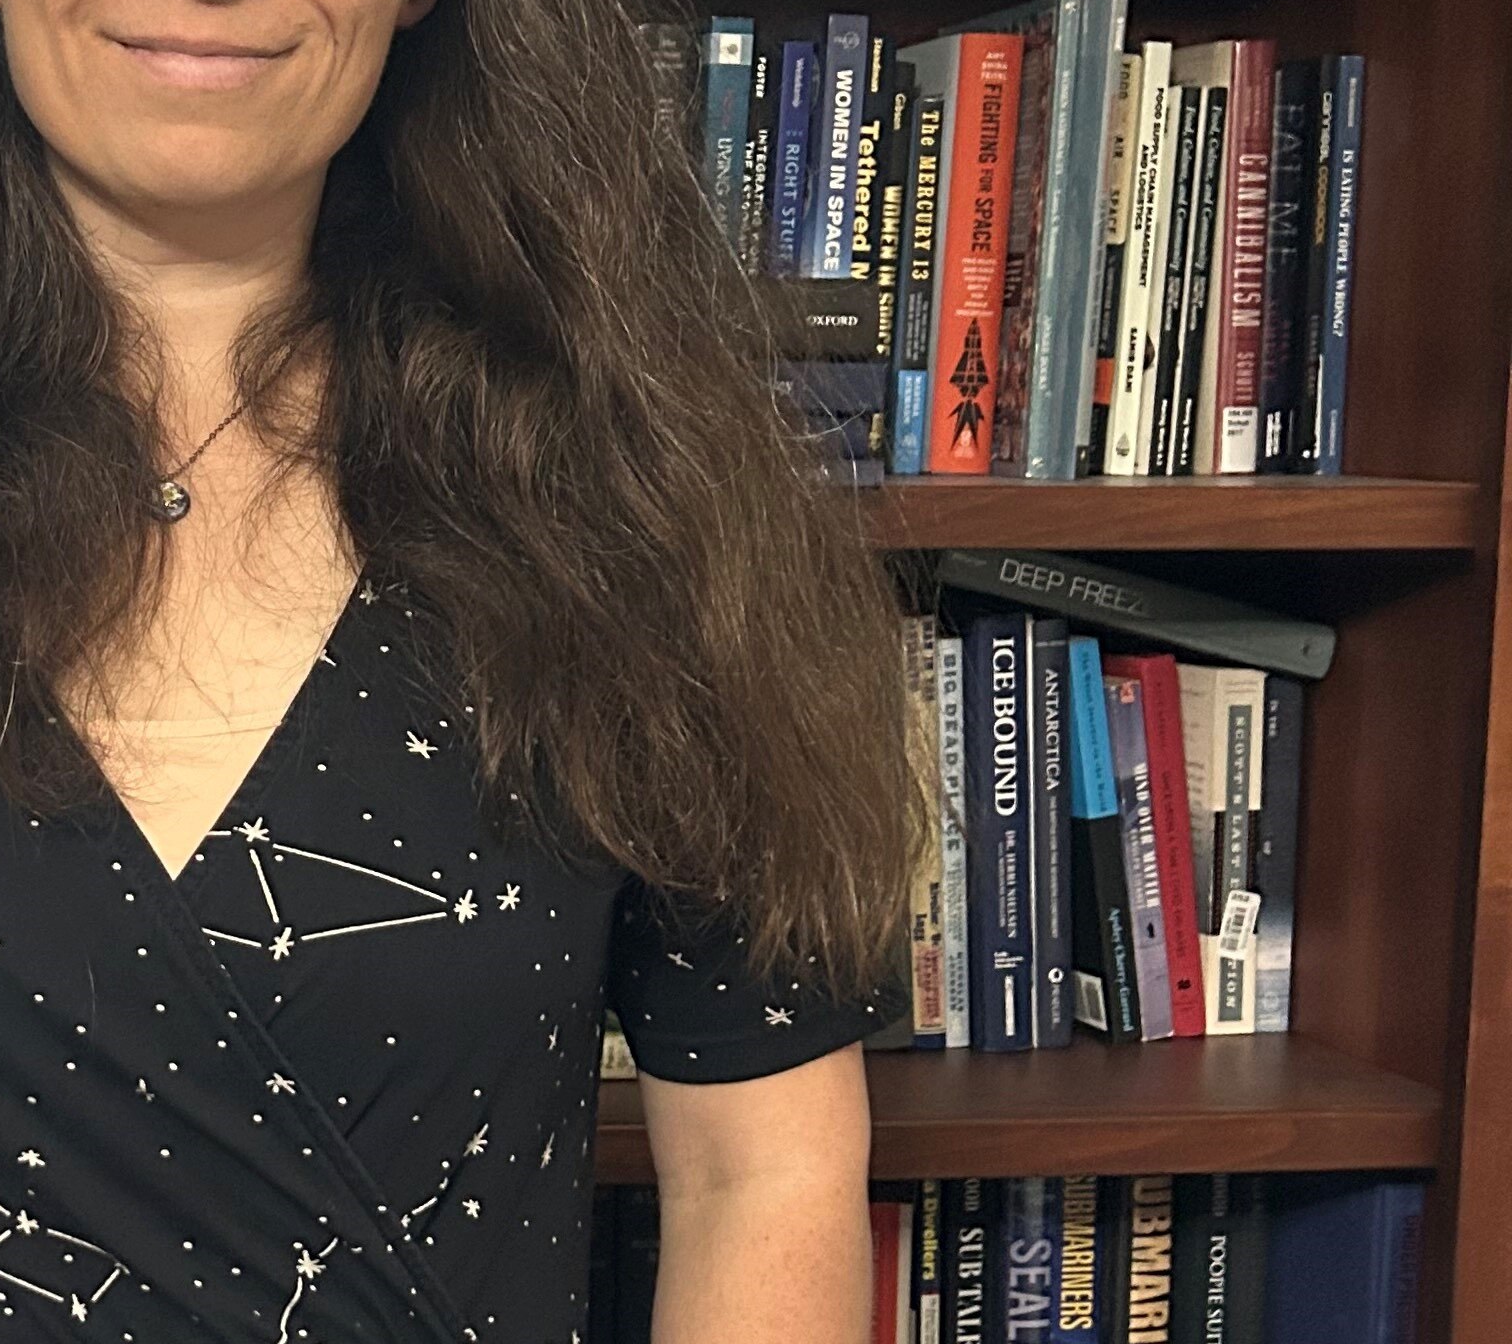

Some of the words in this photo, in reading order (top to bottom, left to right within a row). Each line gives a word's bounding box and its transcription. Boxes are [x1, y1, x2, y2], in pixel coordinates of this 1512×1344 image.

[831, 69, 852, 159] WOMEN
[920, 110, 939, 147] The
[977, 83, 1002, 164] FIGHTING
[828, 165, 846, 189] IN
[850, 119, 879, 251] Tethered
[913, 156, 936, 250] MERCURY
[978, 169, 993, 193] FOR
[822, 195, 844, 271] SPACE
[971, 197, 994, 253] SPACE
[1232, 153, 1268, 329] CANNIBALISM
[911, 259, 929, 280] 13
[807, 314, 858, 326] OXFORD
[991, 637, 1014, 691] ICE
[992, 697, 1016, 815] BOUND
[1044, 668, 1059, 789] ANTARCTICA
[957, 1227, 984, 1279] SUB
